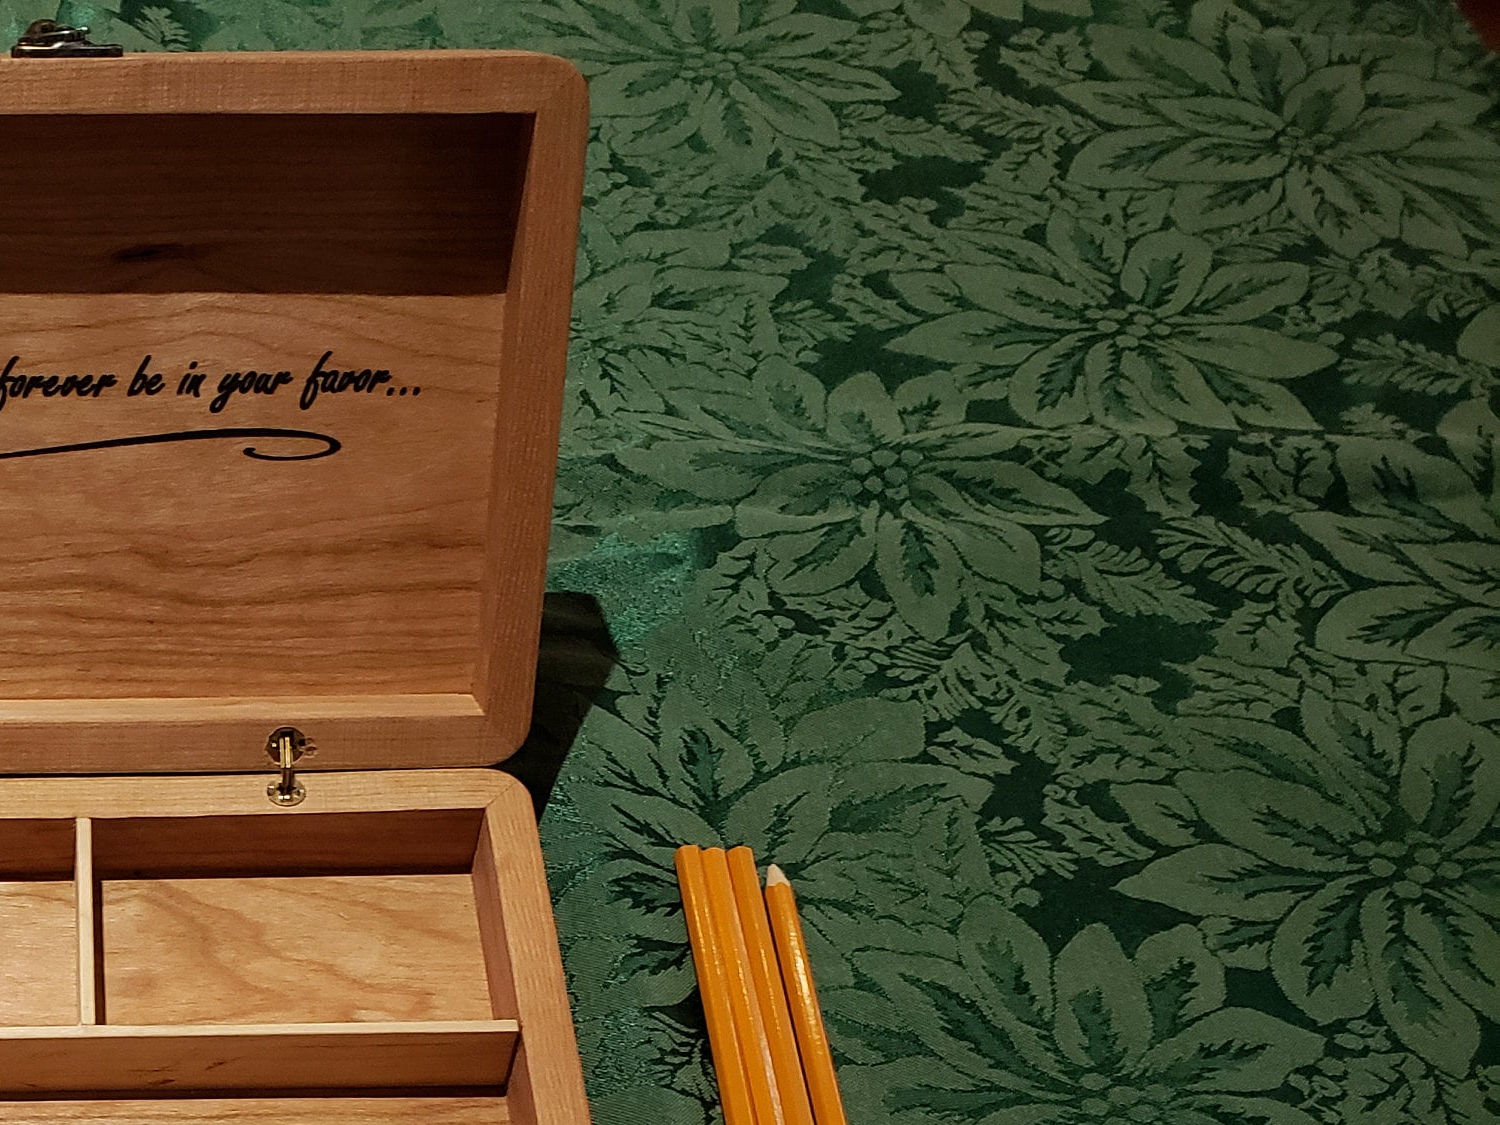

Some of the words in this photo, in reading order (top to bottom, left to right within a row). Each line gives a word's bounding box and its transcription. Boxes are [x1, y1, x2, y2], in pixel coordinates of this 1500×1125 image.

[126, 354, 166, 397] be
[176, 360, 207, 398] in
[209, 369, 294, 414] your
[299, 350, 421, 410] favor...
